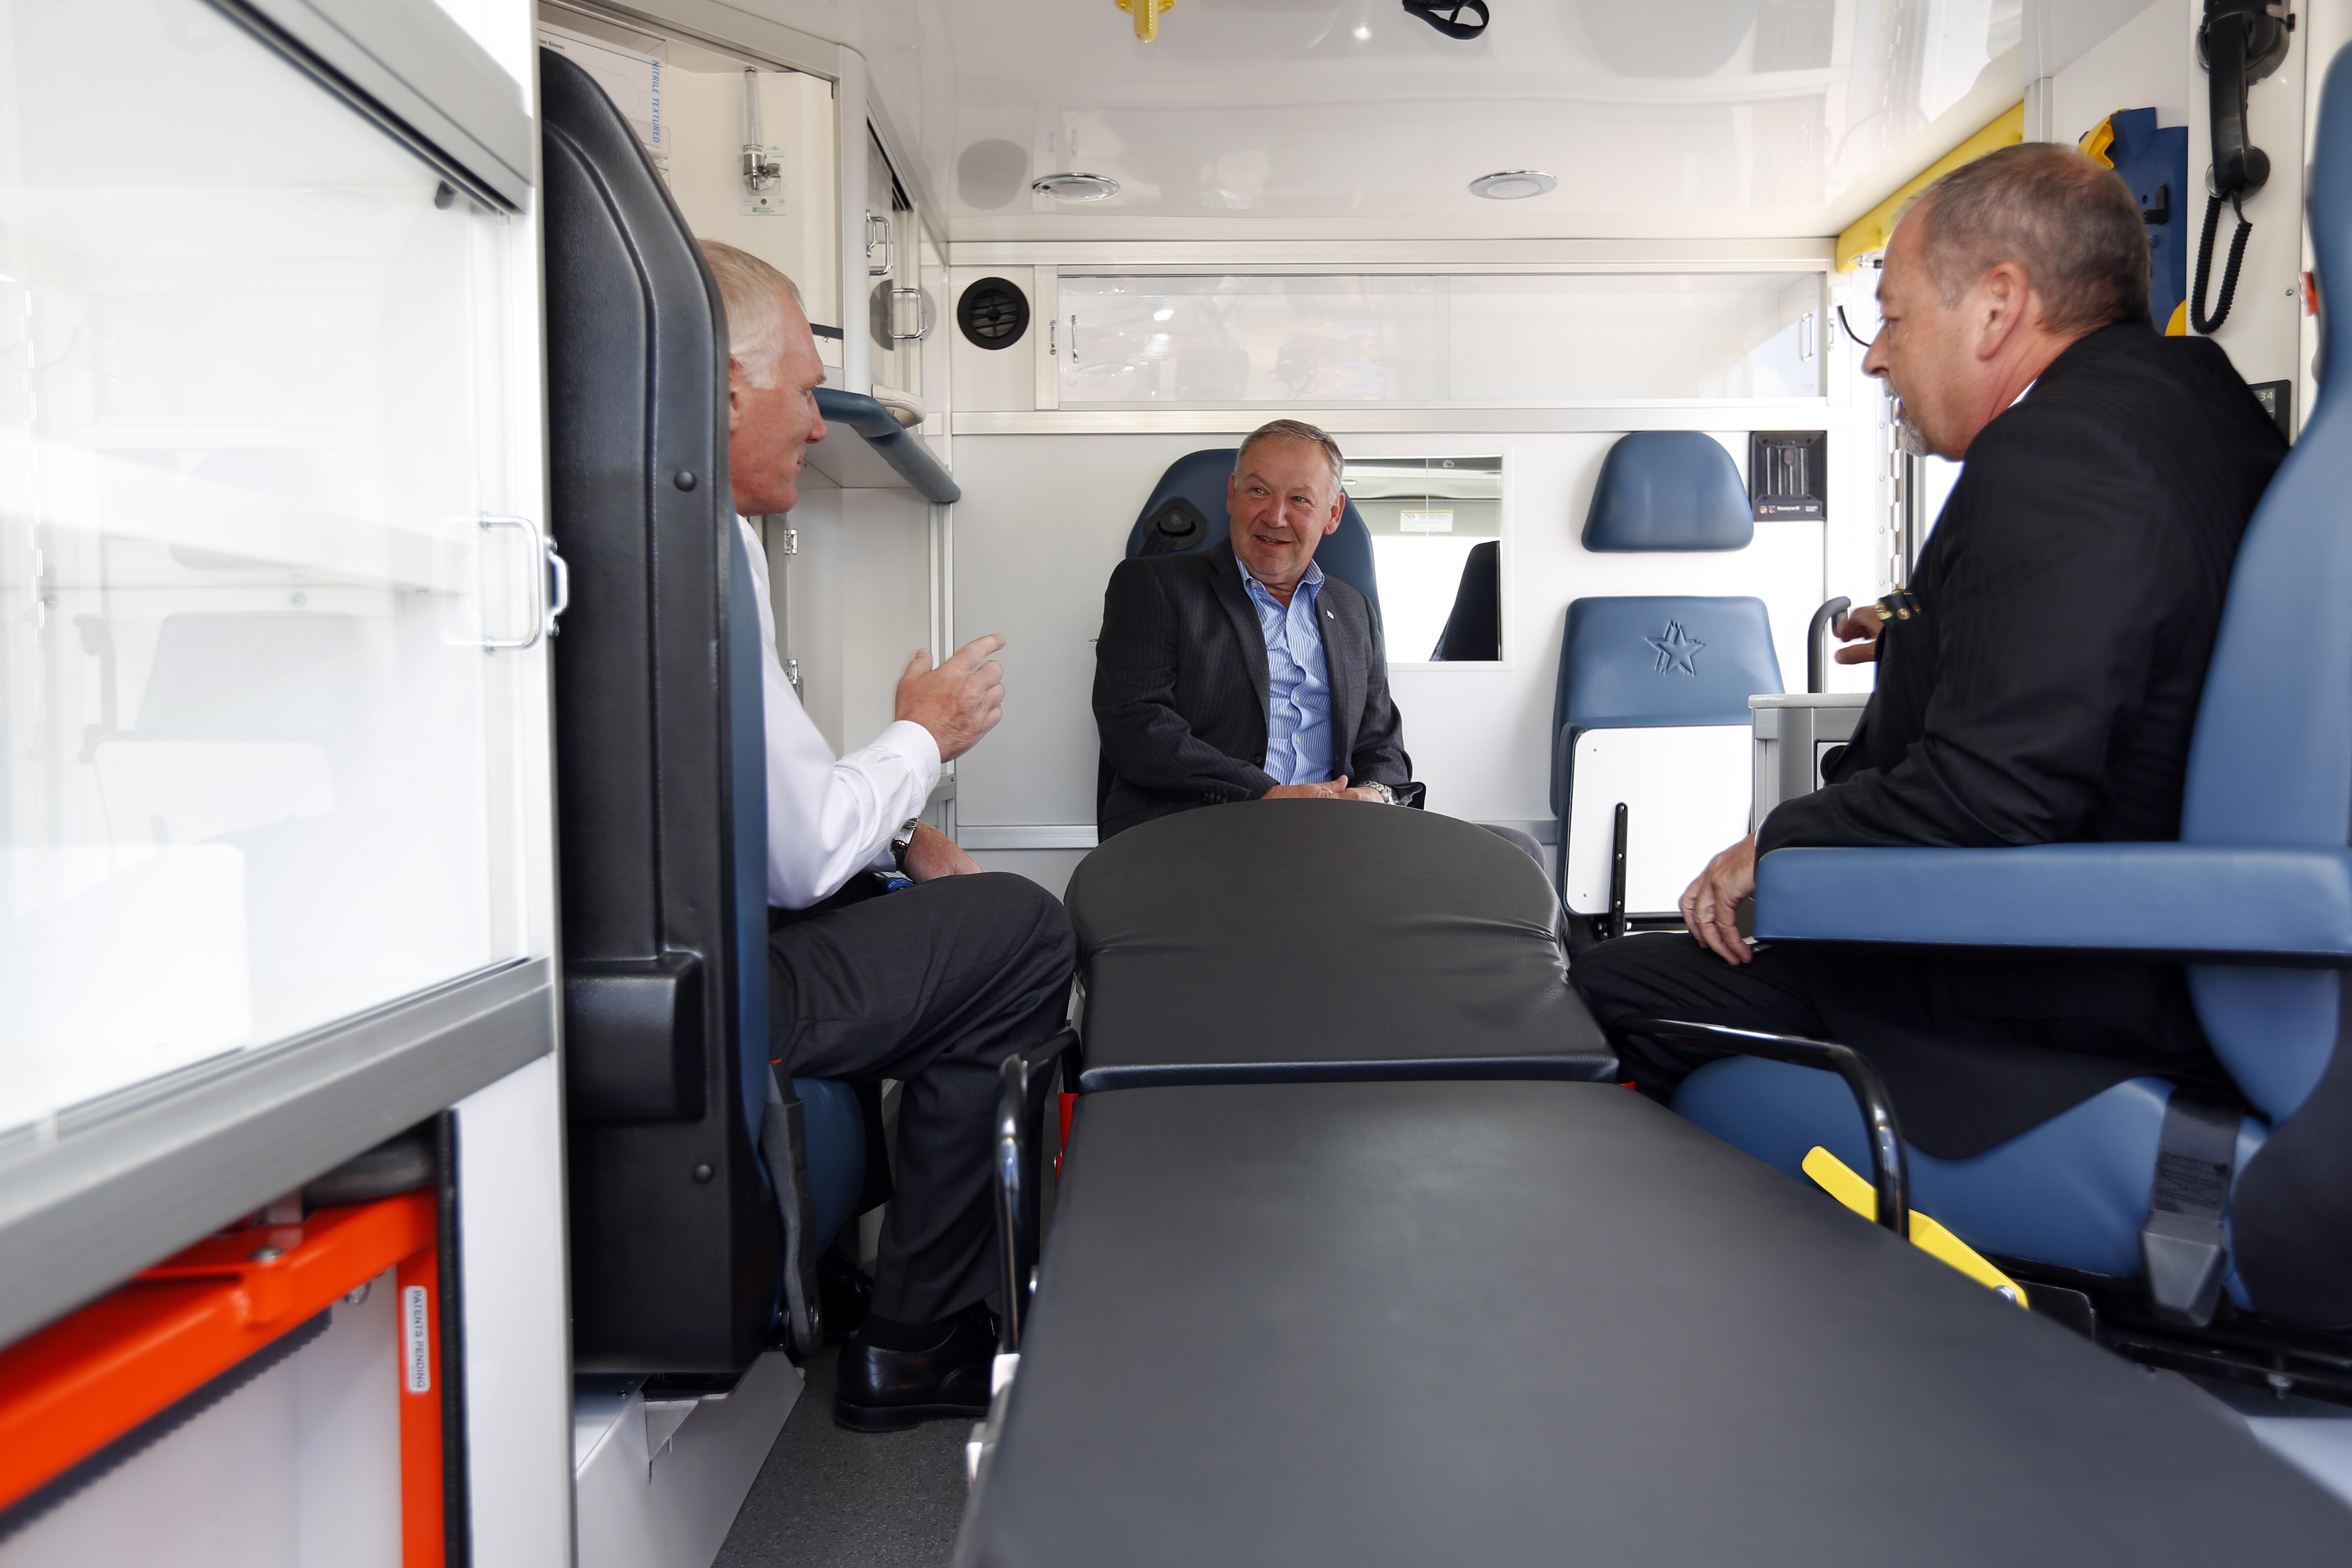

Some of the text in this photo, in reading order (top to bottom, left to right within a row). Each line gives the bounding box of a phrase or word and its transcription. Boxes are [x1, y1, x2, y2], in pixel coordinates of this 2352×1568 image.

[548, 41, 564, 50] Gloves
[2260, 391, 2273, 401] 34
[414, 1290, 426, 1388] PATENTS PENDING
